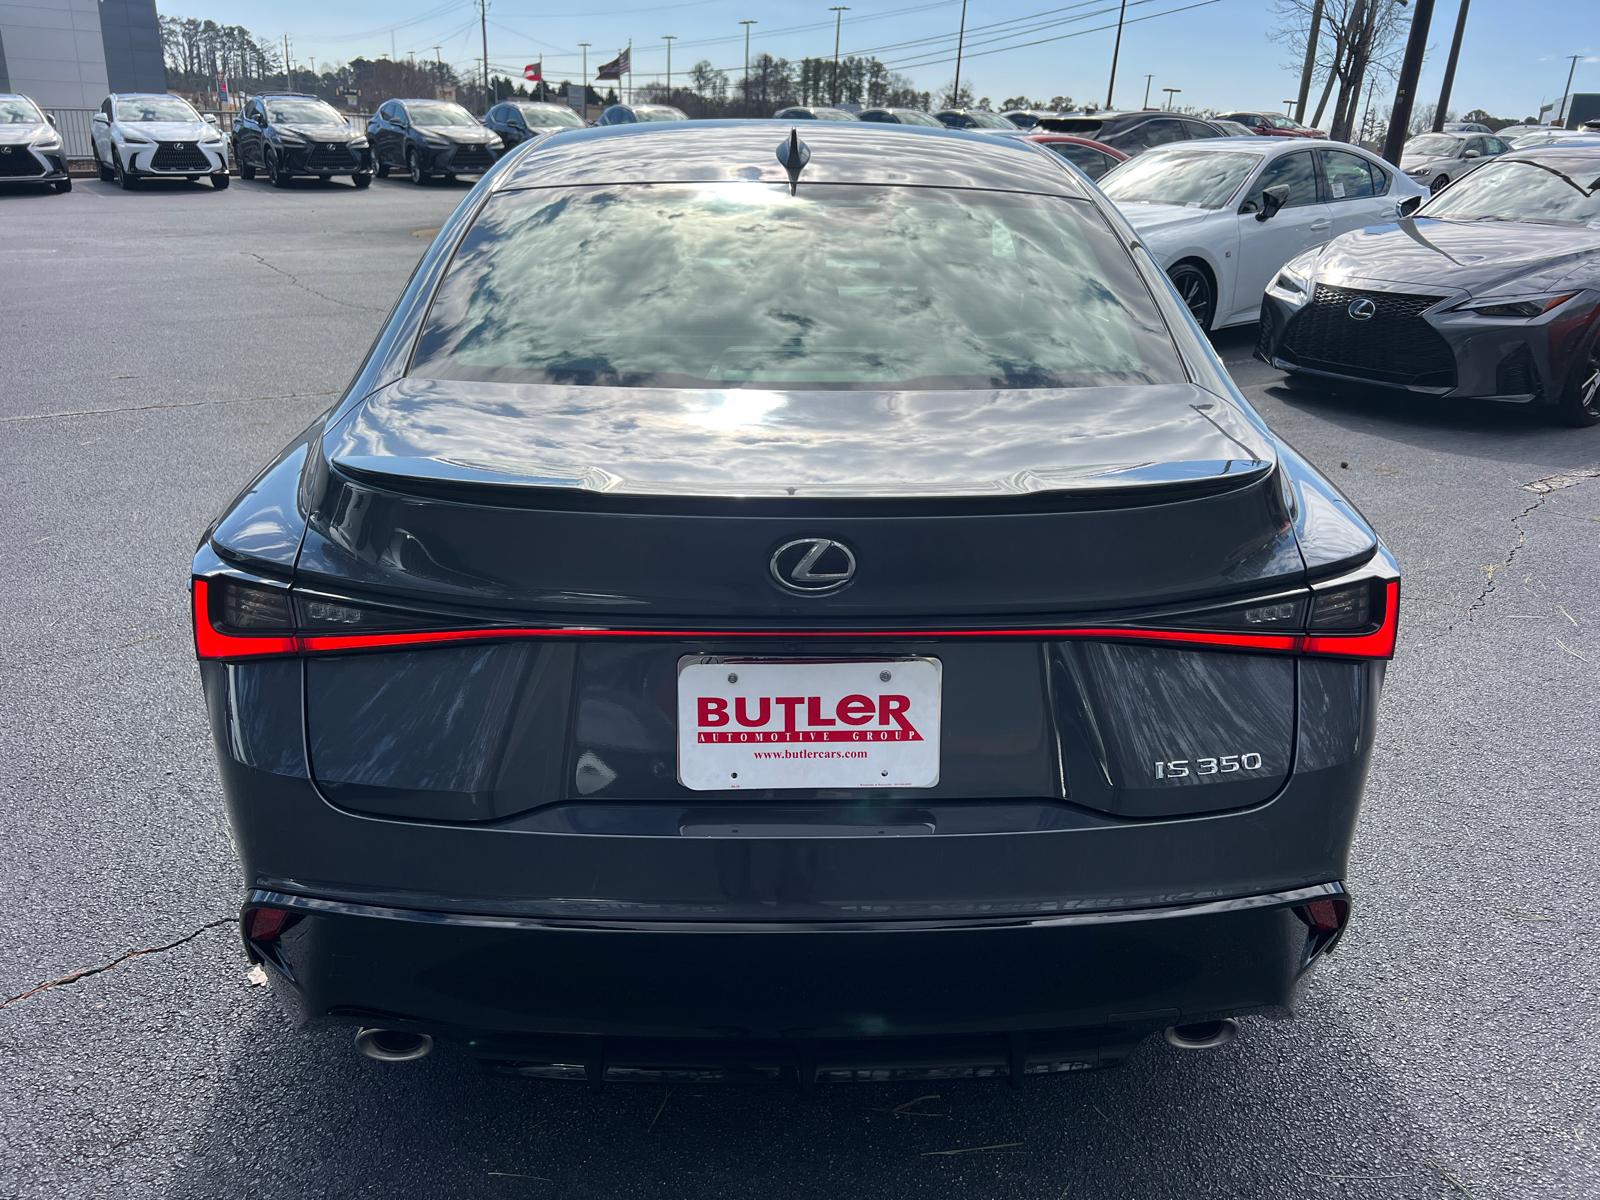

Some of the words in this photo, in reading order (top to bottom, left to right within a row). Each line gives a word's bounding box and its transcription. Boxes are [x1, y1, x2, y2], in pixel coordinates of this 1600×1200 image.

[699, 732, 830, 742] AUTOMOTIVE
[853, 731, 915, 741] GROUP
[754, 750, 868, 760] www.butlercars.com
[1155, 760, 1189, 779] IS
[1197, 752, 1262, 775] 350
